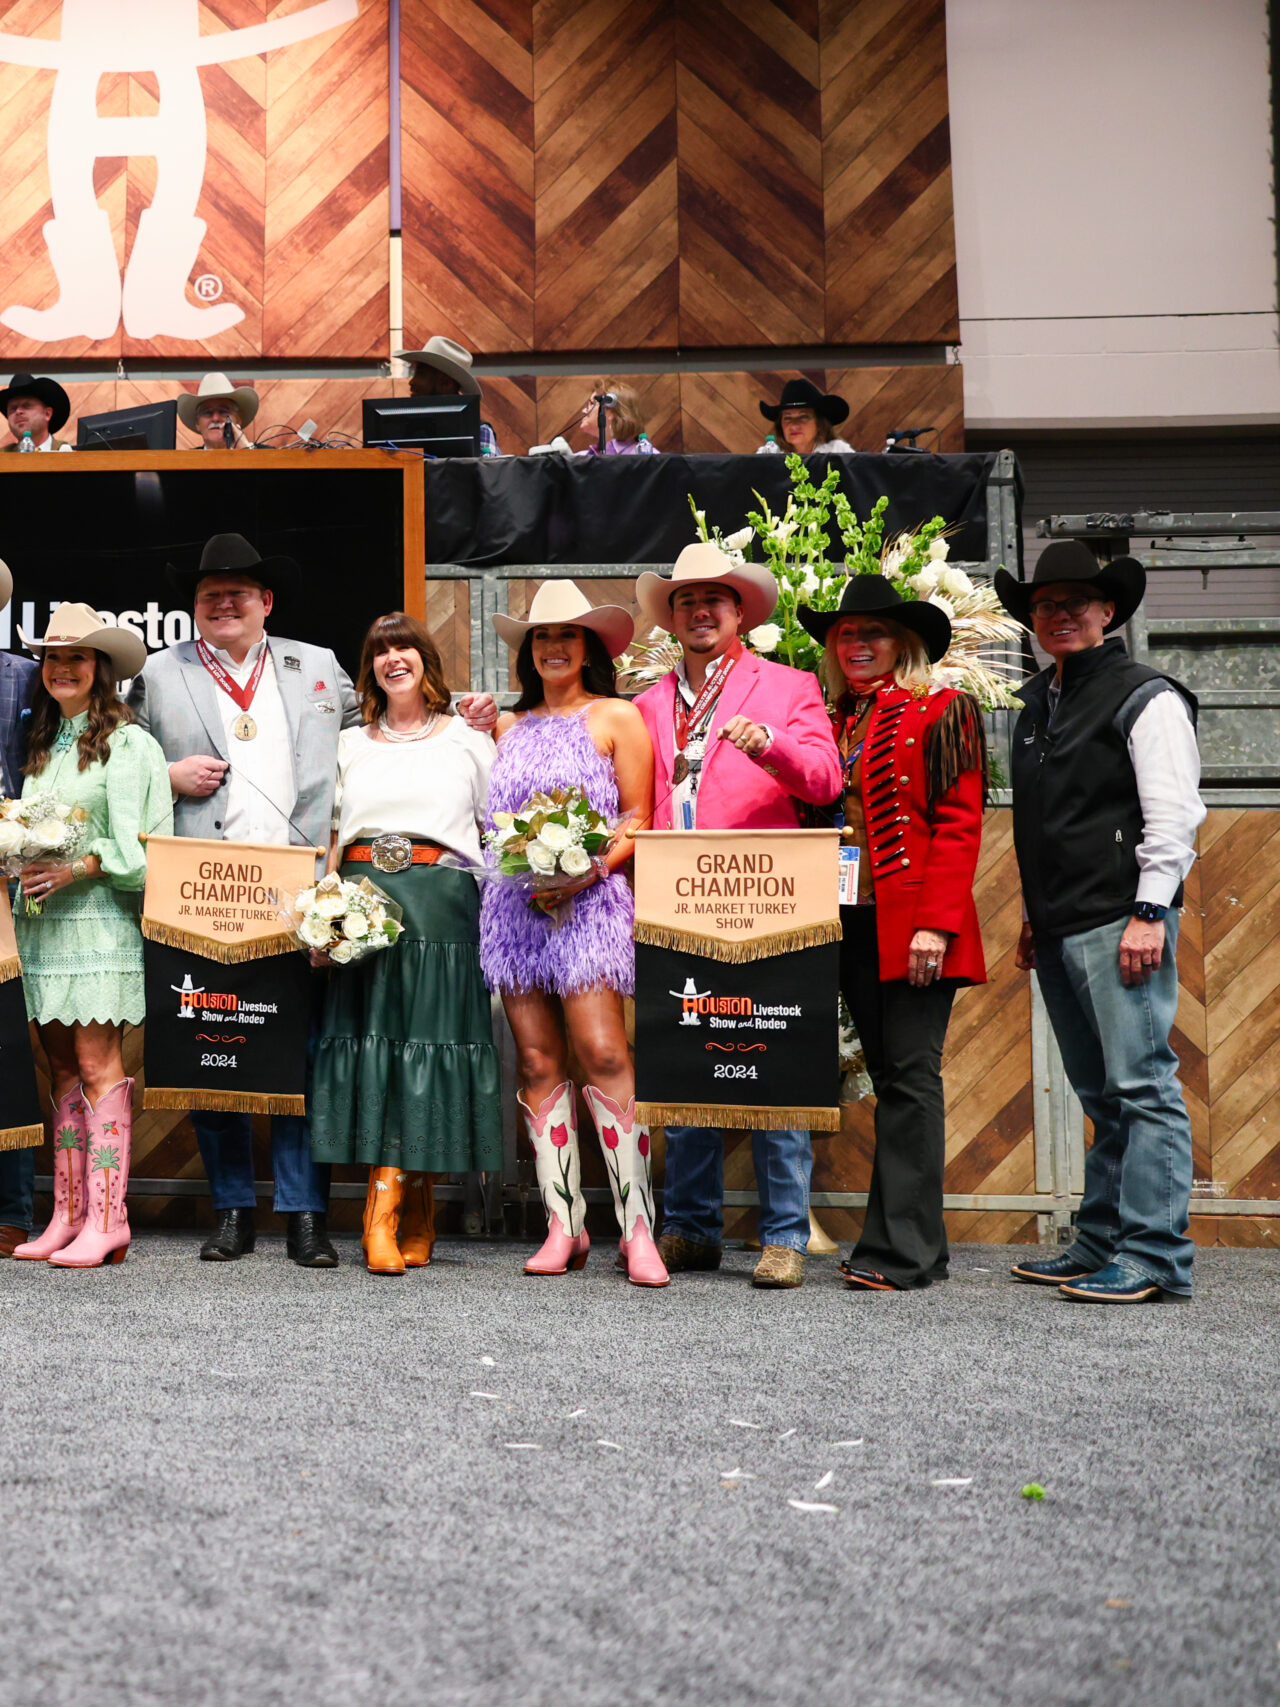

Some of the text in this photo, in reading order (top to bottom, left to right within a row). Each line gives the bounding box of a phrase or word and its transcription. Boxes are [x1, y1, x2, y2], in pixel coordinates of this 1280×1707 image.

[697, 854, 773, 873] GRAND
[199, 862, 262, 882] GRAND
[180, 882, 278, 905] CHAMPION
[676, 877, 795, 897] CHAMPION
[178, 906, 280, 921] JR. MARKET TURKEY
[674, 903, 796, 914] JR. MARKET TURKEY
[213, 921, 244, 932] SHOW
[716, 918, 754, 929] SHOW
[238, 1001, 277, 1013] Livestock
[753, 1004, 801, 1016] Livestock
[202, 1011, 264, 1024] Show and Rodeo
[710, 1017, 786, 1029] Show and Rodeo
[201, 1054, 237, 1067] 2024
[714, 1065, 757, 1079] 2024
